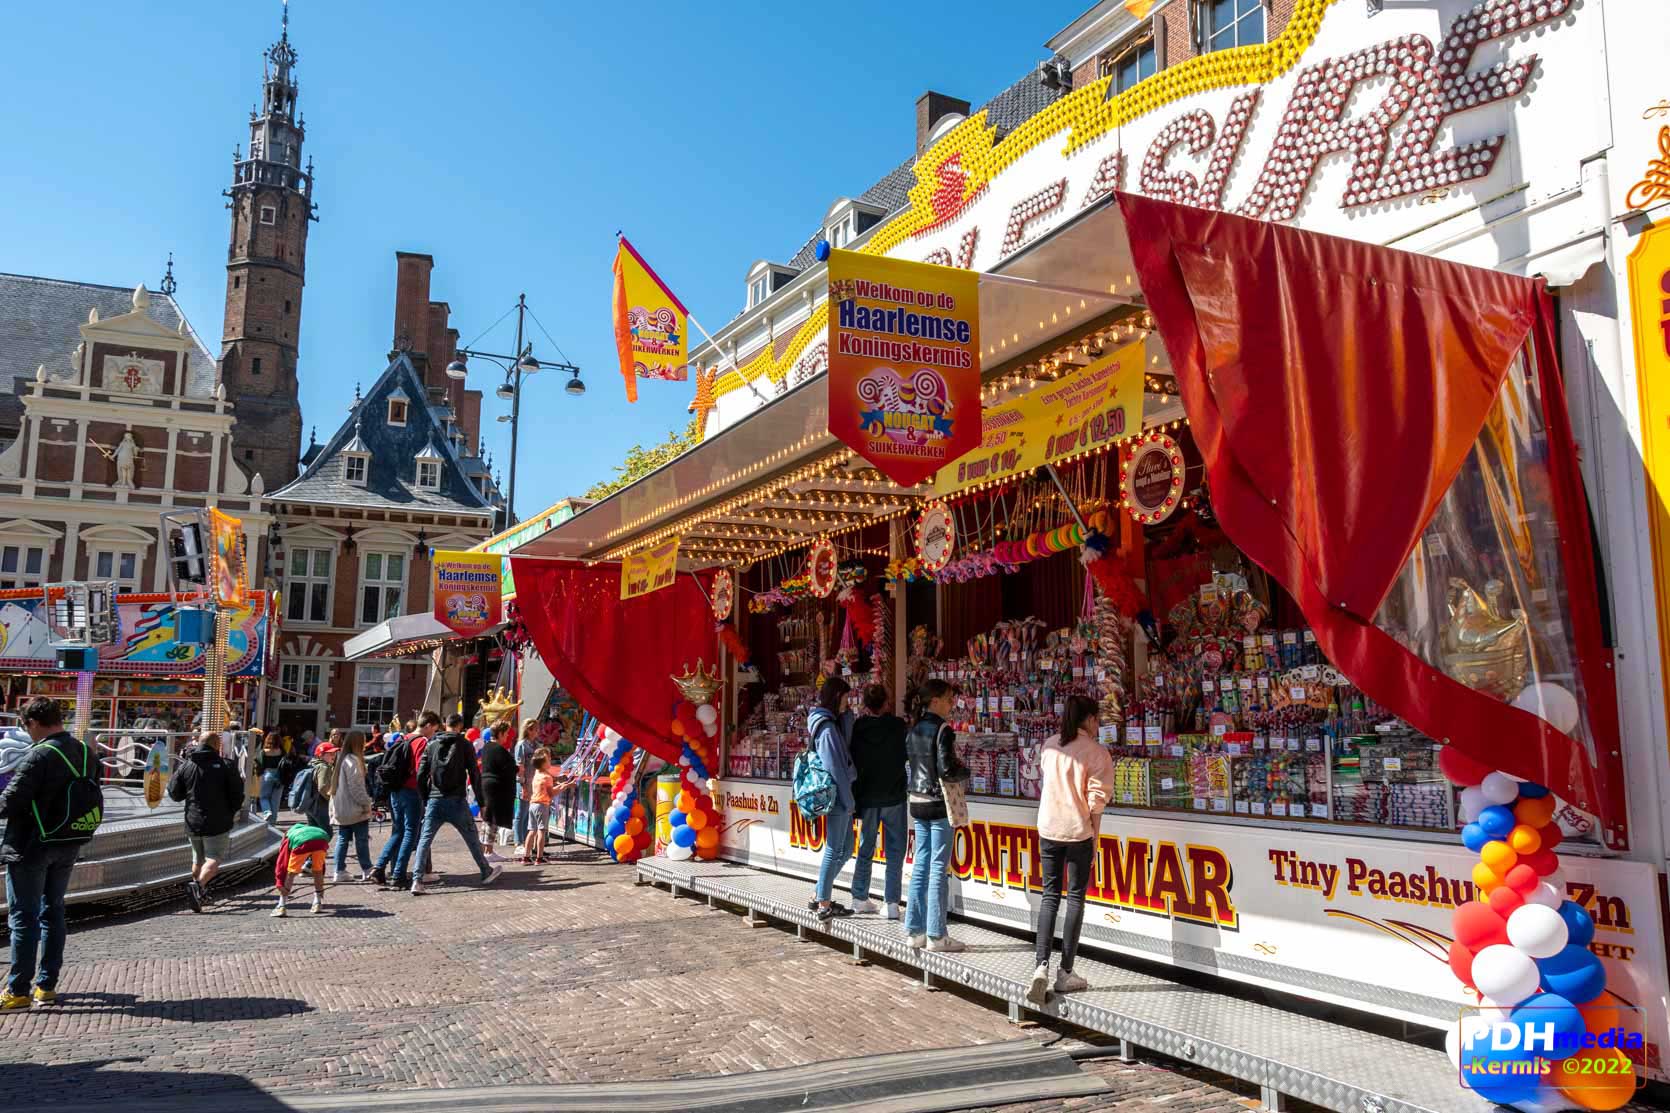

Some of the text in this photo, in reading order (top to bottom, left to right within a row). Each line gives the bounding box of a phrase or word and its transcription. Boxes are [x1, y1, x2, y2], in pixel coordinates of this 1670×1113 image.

[855, 279, 955, 310] Welkom op de
[839, 300, 971, 344] Haarlemse
[839, 332, 971, 368] Koningskermis
[883, 411, 936, 431] NOUGAT
[906, 425, 917, 442] &
[1055, 428, 1078, 456] voor
[1079, 422, 1088, 447] €
[1090, 407, 1125, 443] 12,50
[869, 441, 945, 458] SUIKERWERKEN
[966, 457, 990, 481] voor
[990, 452, 1000, 474] €
[438, 569, 497, 582] Haarlemse
[726, 791, 759, 811] Paashuis
[760, 794, 767, 811] &
[767, 795, 780, 813] Zn
[1268, 849, 1340, 898] Tiny
